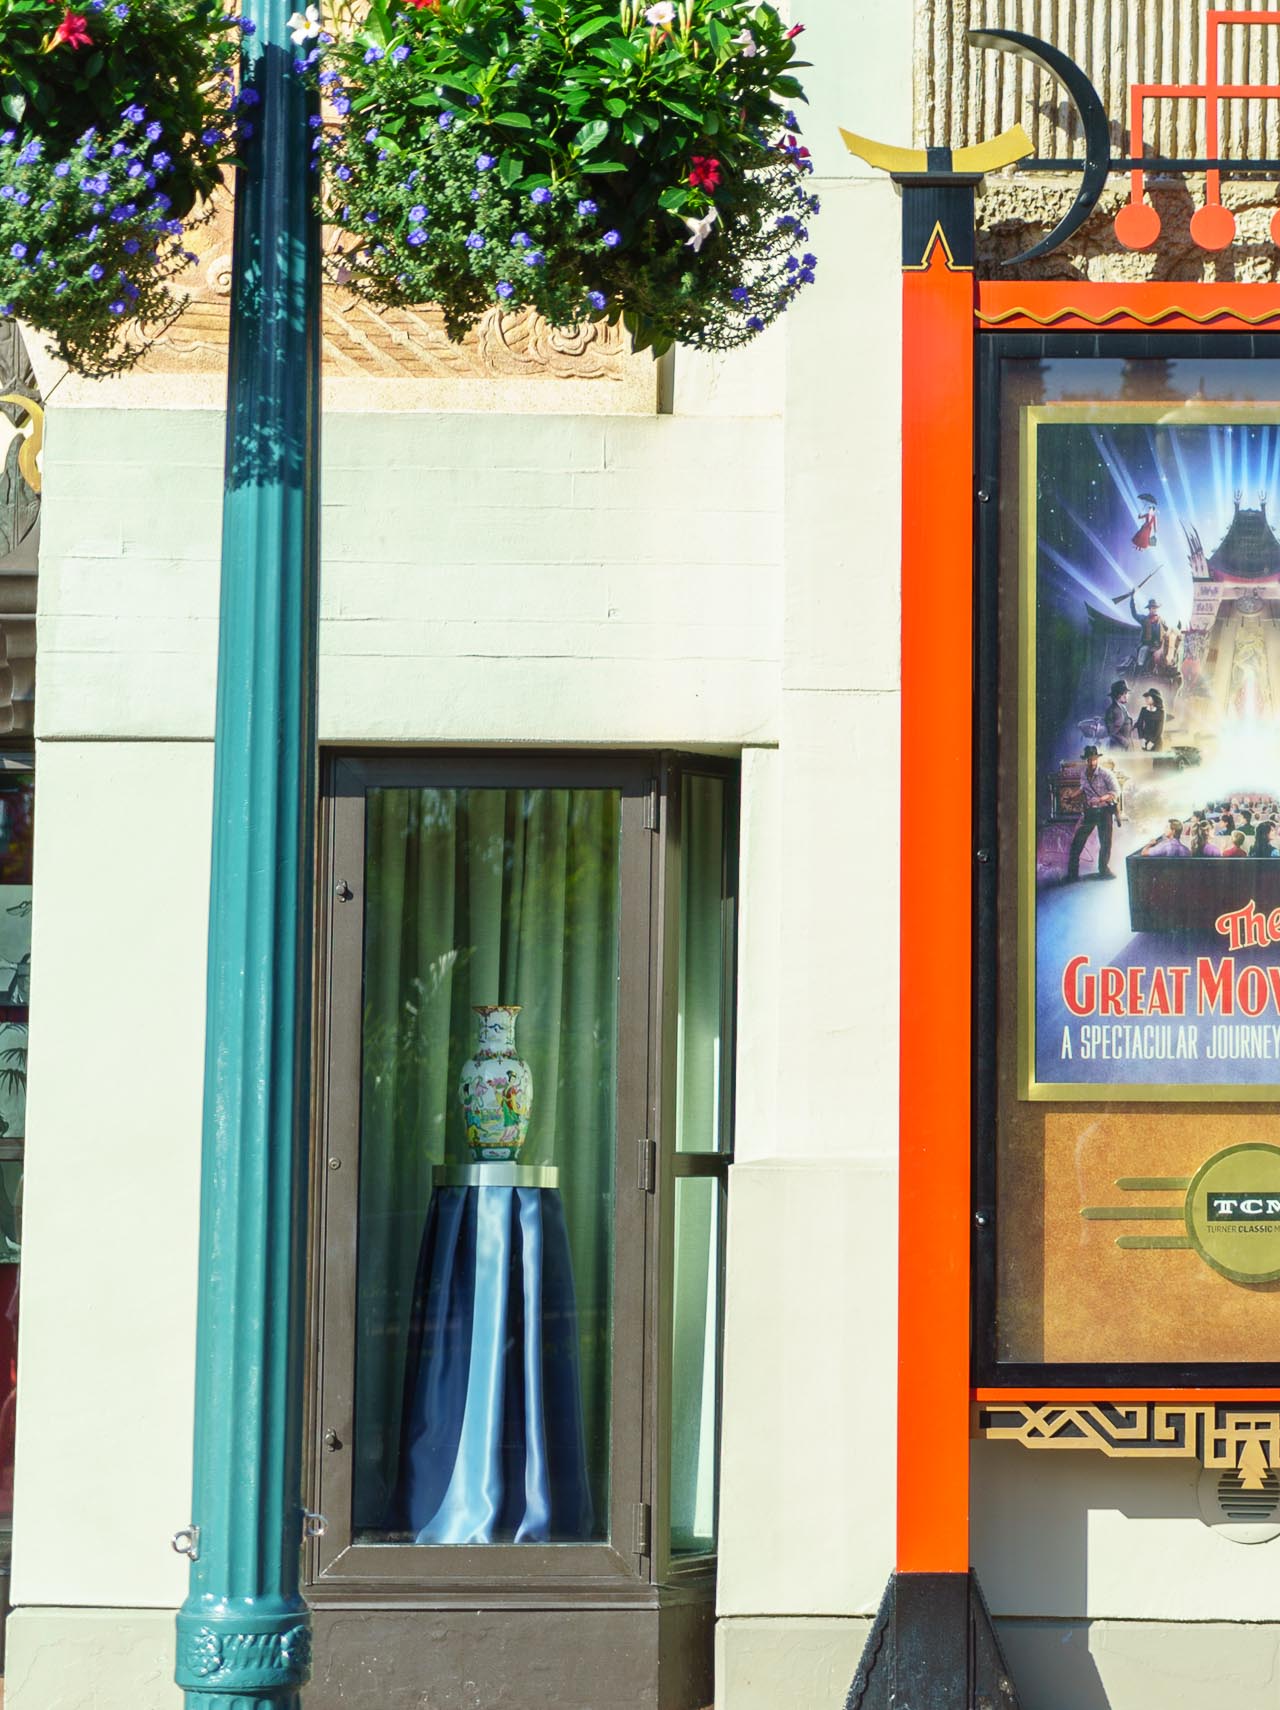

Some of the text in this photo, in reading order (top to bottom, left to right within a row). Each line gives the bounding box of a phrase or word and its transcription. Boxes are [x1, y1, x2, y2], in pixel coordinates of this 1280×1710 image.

[1062, 955, 1191, 1017] GREAT
[1061, 1025, 1073, 1060] A
[1080, 1025, 1198, 1060] SPECTACULAR
[1207, 1225, 1237, 1233] TURNER
[1238, 1225, 1273, 1233] CLASSIC
